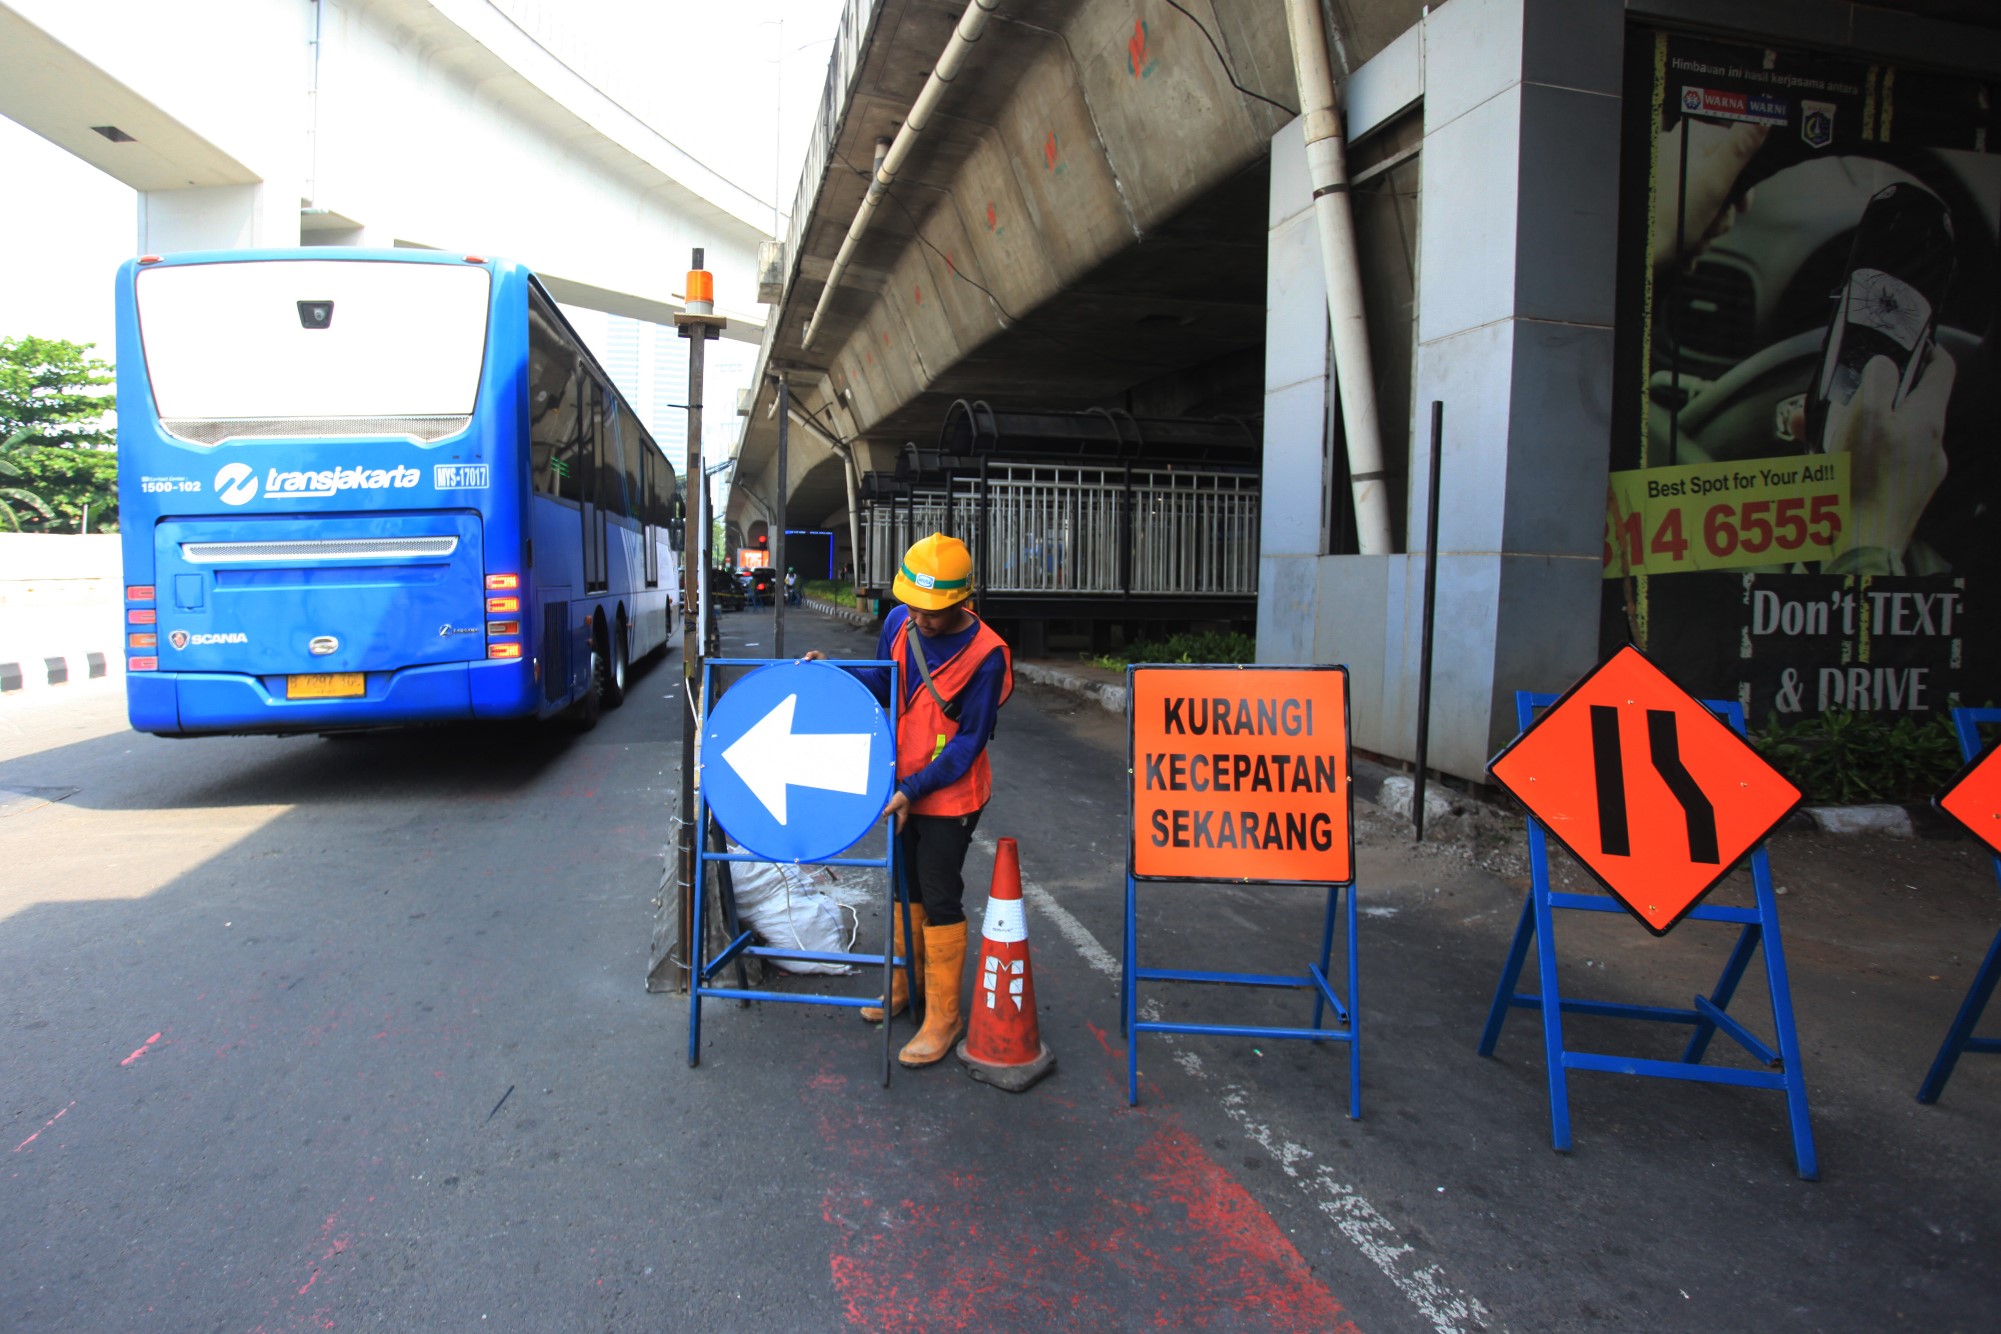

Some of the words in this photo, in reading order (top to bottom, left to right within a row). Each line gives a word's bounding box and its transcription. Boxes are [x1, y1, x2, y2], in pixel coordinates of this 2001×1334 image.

[1672, 57, 1725, 76] Himbauan
[1728, 66, 1743, 79] ini
[1745, 70, 1769, 82] hasil
[1771, 72, 1825, 90] kerjasama
[1827, 82, 1858, 96] antara
[1704, 93, 1745, 110] WARNA
[1749, 101, 1787, 117] WARNI
[142, 481, 201, 493] 1500-102
[264, 464, 420, 499] transjakarta
[437, 467, 487, 488] MYS-17017
[1648, 480, 1686, 498] Best
[1690, 475, 1729, 496] Spot
[1733, 472, 1756, 489] for
[1760, 469, 1797, 487] Your
[1801, 464, 1835, 482] Ad!!
[1703, 494, 1842, 558] 6555
[1752, 589, 1856, 636] Don't
[1867, 591, 1960, 636] TEXT
[192, 632, 248, 645] SCANIA
[1775, 667, 1804, 713] &
[1817, 667, 1930, 711] DRIVE
[1163, 697, 1314, 737] KURANGI
[1145, 753, 1337, 794] KECEPATAN
[1150, 808, 1333, 853] SEKARANG
